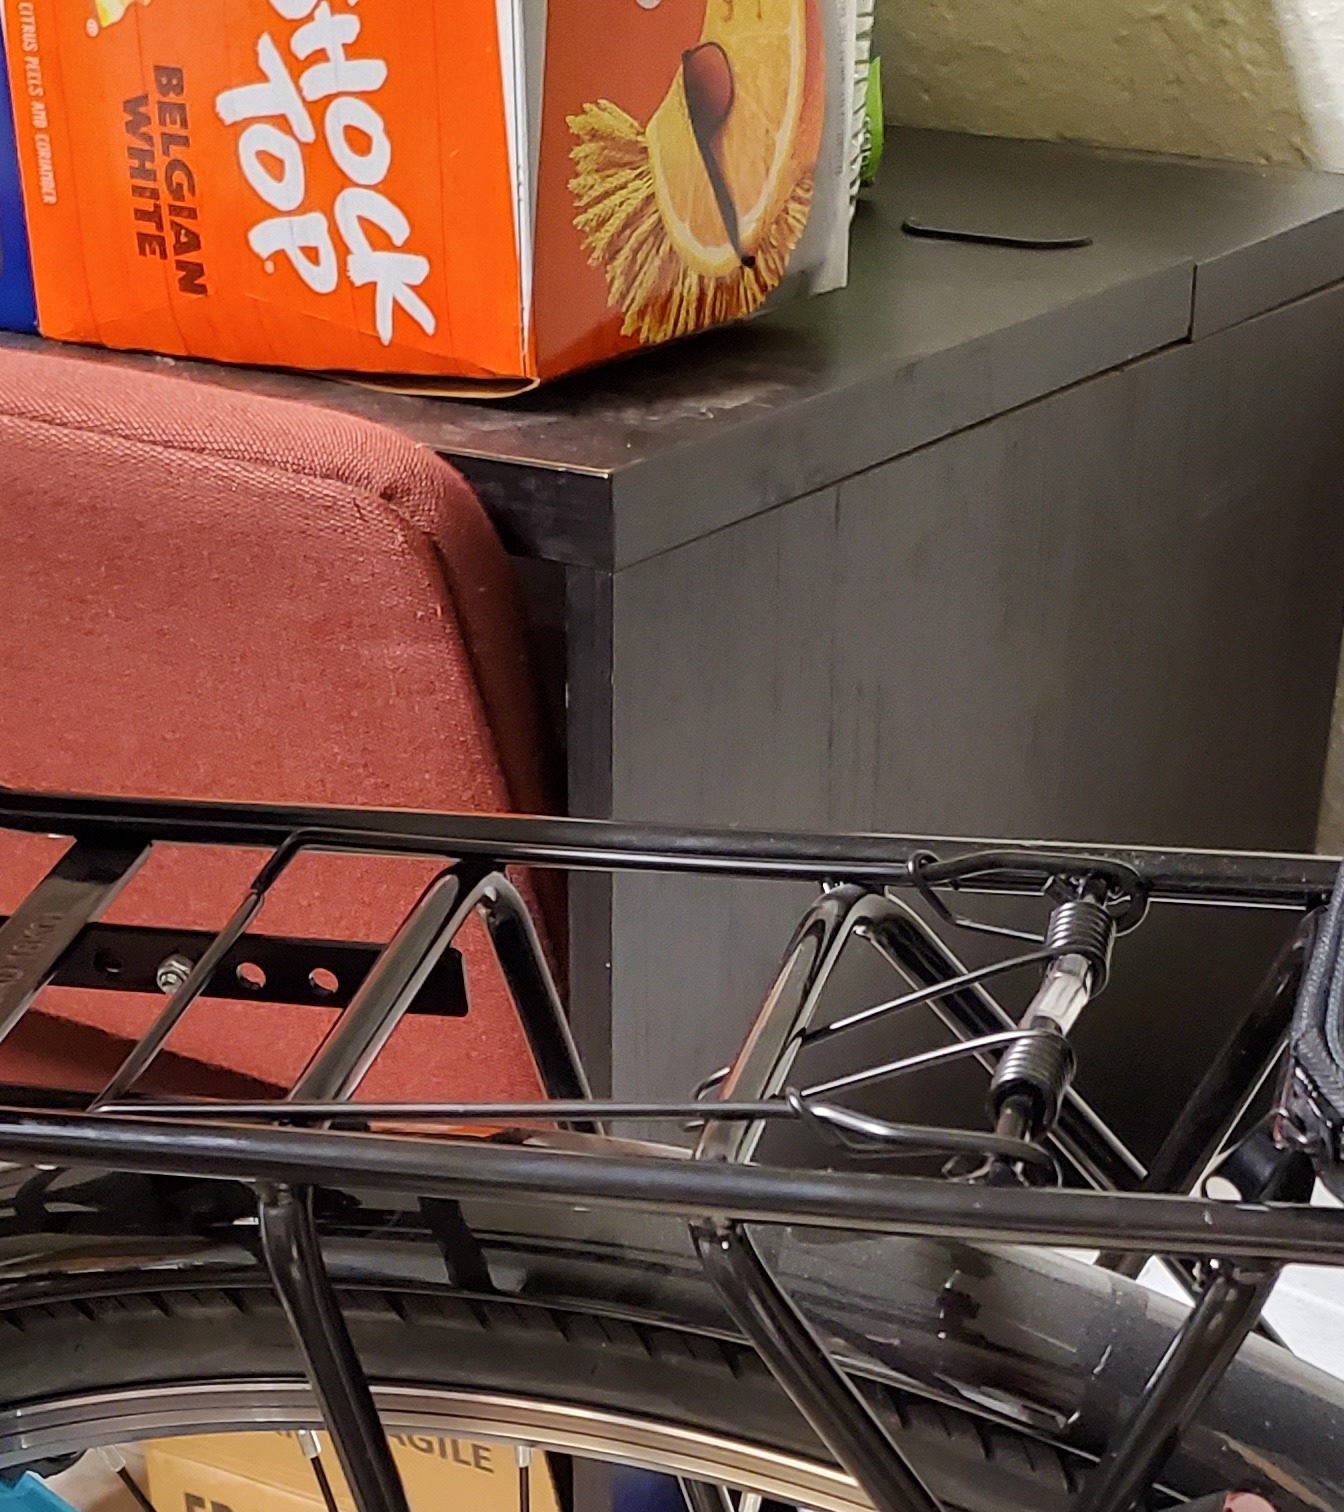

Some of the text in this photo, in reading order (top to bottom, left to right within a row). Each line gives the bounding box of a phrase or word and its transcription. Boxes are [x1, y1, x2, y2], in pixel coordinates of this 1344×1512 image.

[18, 2, 39, 53] CITRUS
[24, 56, 45, 98] PEELS
[31, 100, 49, 129] AND
[215, 31, 338, 294] TOP
[122, 92, 168, 261] WHITE
[153, 64, 209, 297] BELGIAN
